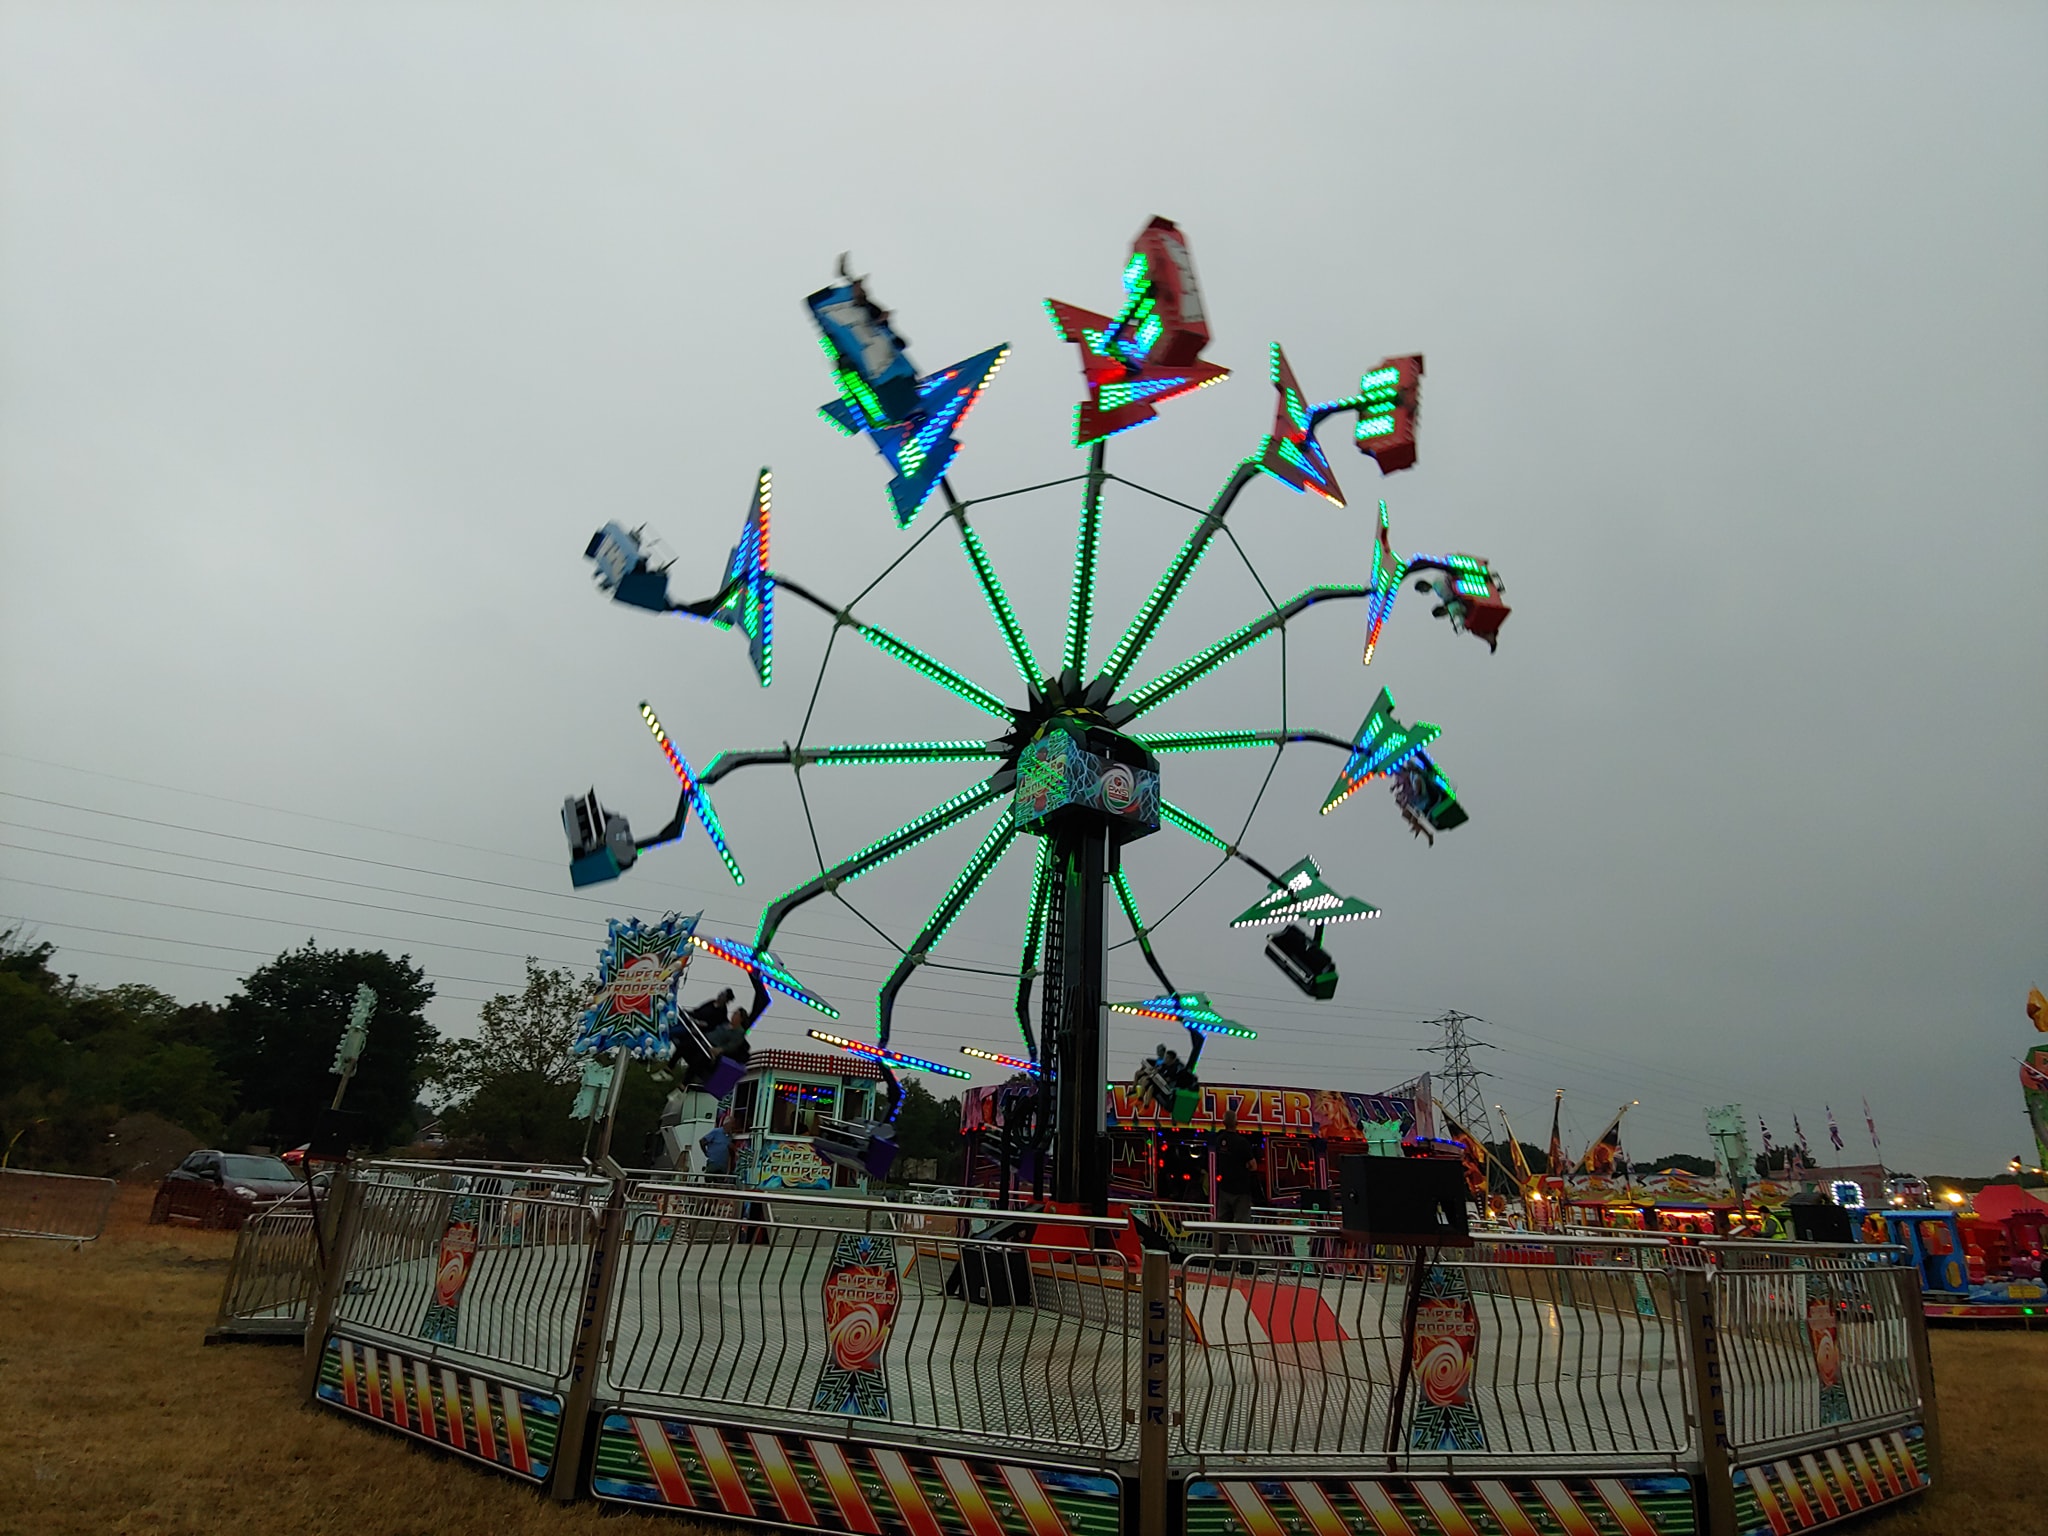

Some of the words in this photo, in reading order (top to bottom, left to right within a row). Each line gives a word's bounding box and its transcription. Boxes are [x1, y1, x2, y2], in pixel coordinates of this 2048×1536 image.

[617, 968, 663, 981] SUPER
[606, 983, 669, 995] TROOPER
[1113, 1085, 1313, 1126] WLTZER
[770, 1150, 823, 1166] SUPER
[762, 1163, 832, 1181] TROOPER
[837, 1273, 887, 1290] SUPER
[827, 1285, 896, 1305] TROOPER
[1416, 1322, 1476, 1336] ROOPER
[1147, 1301, 1166, 1425] SUPER
